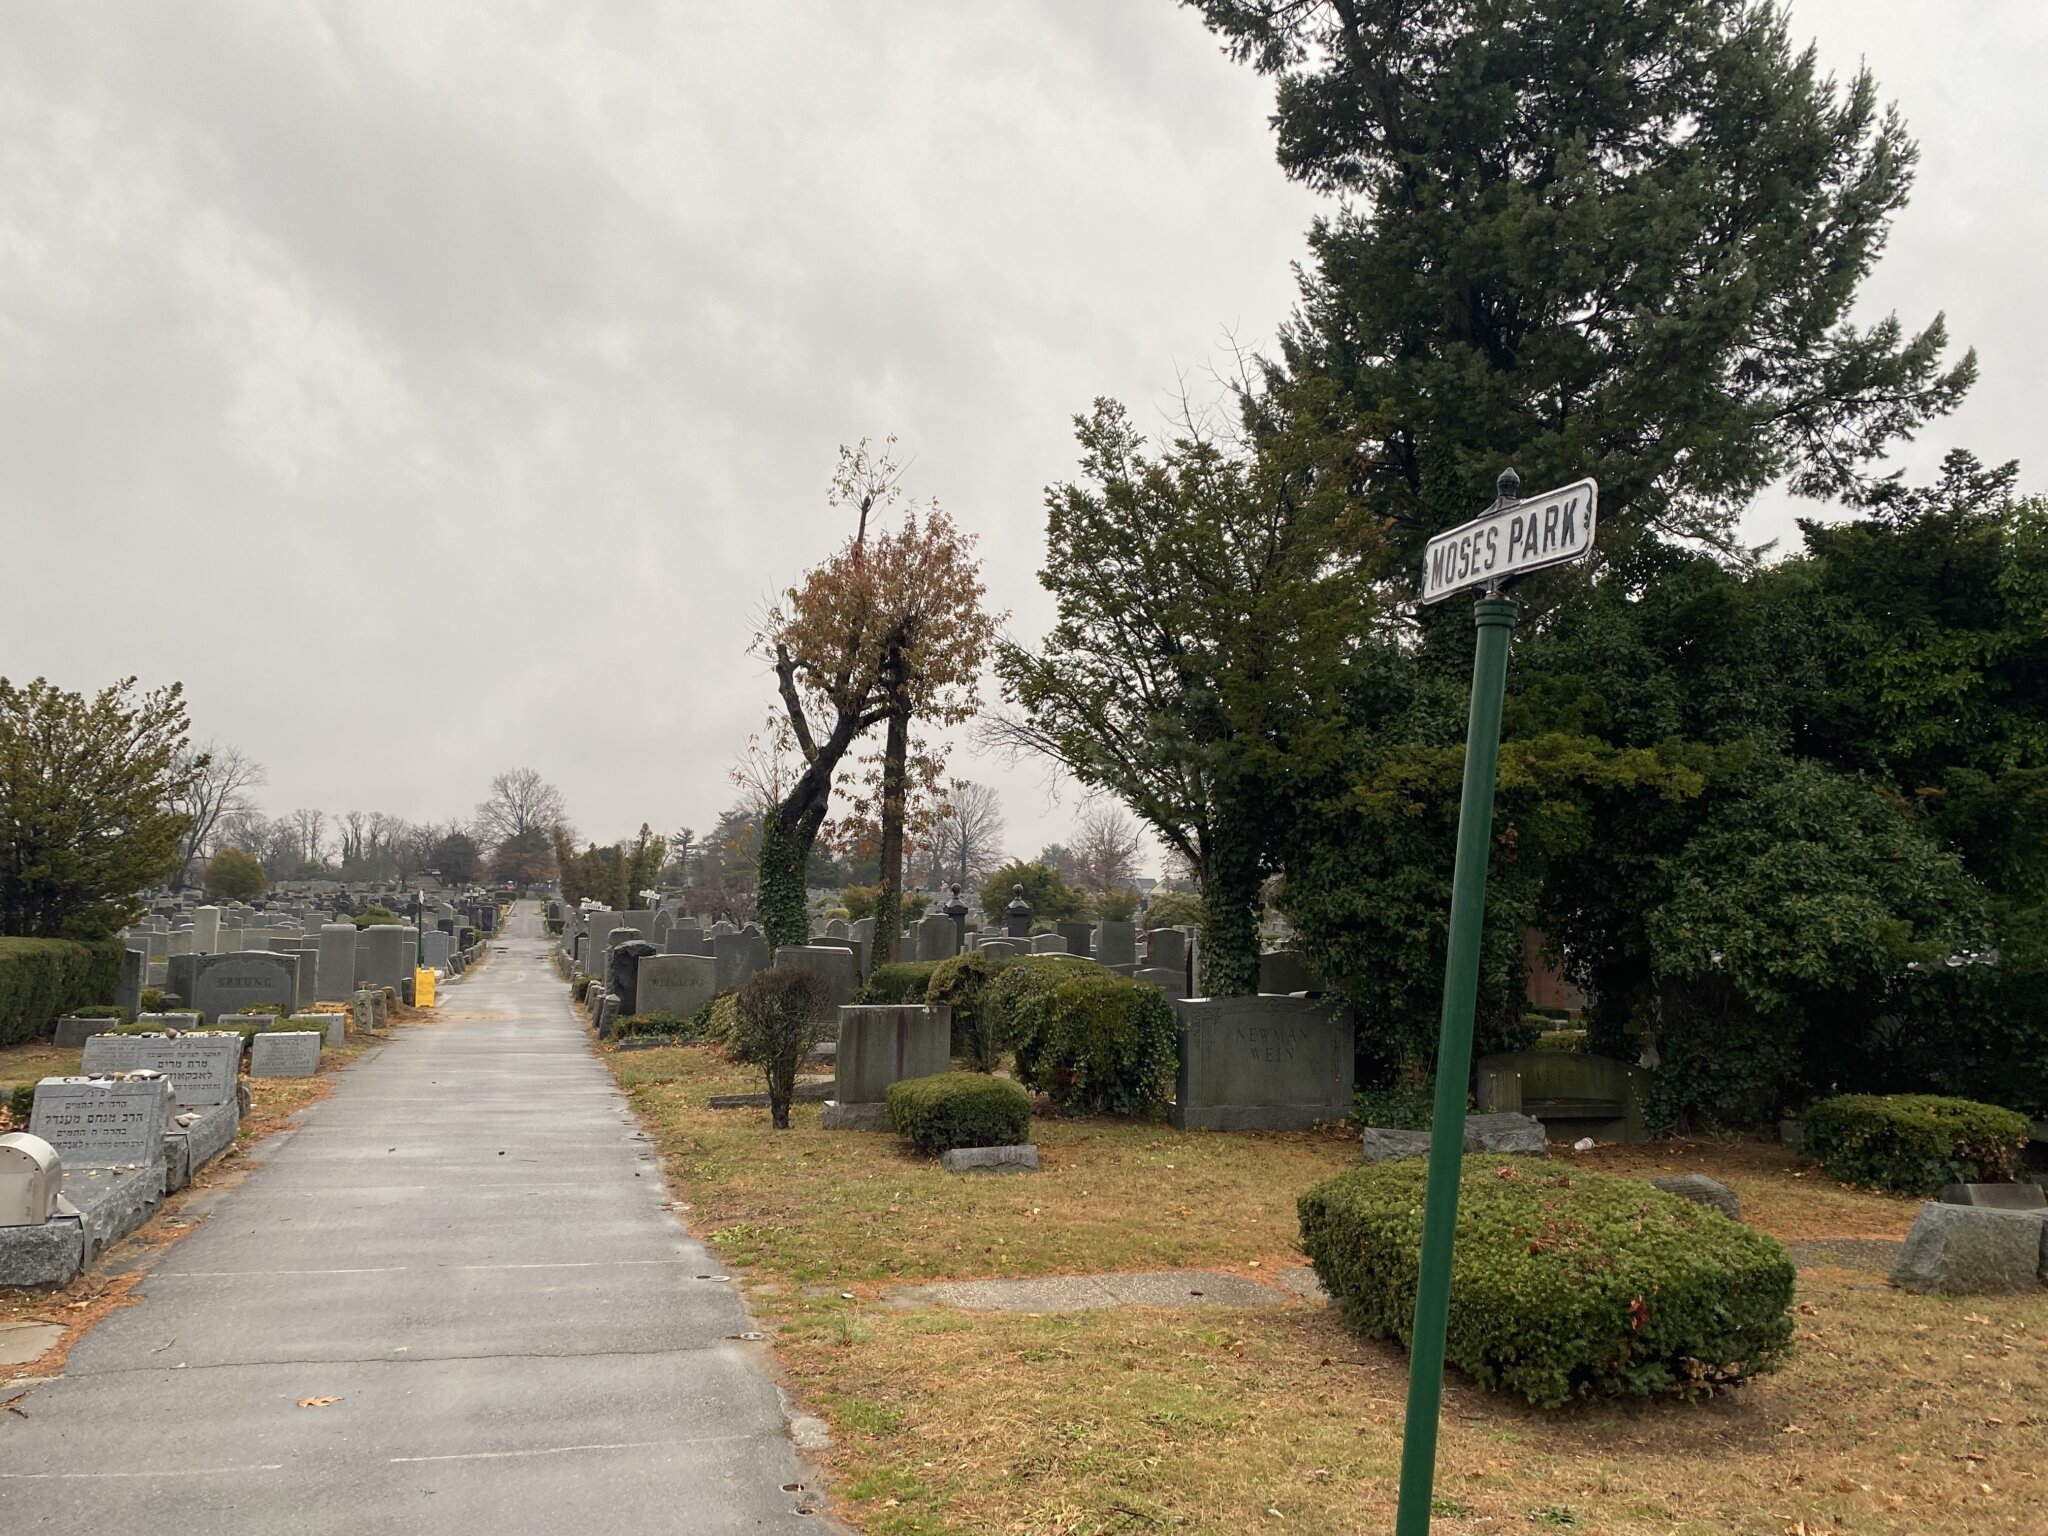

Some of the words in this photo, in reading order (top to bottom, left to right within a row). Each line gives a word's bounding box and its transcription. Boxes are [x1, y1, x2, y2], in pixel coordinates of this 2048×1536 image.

[1430, 525, 1499, 591] MOSES
[1507, 497, 1578, 564] PARK
[1235, 1027, 1308, 1042] NEWMAN
[1250, 1047, 1296, 1063] WEIN
[157, 1060, 182, 1069] מרים
[187, 1060, 208, 1069] מרת
[45, 1113, 81, 1125] מענדל
[87, 1113, 116, 1123] מנחם
[121, 1113, 144, 1123] הרב
